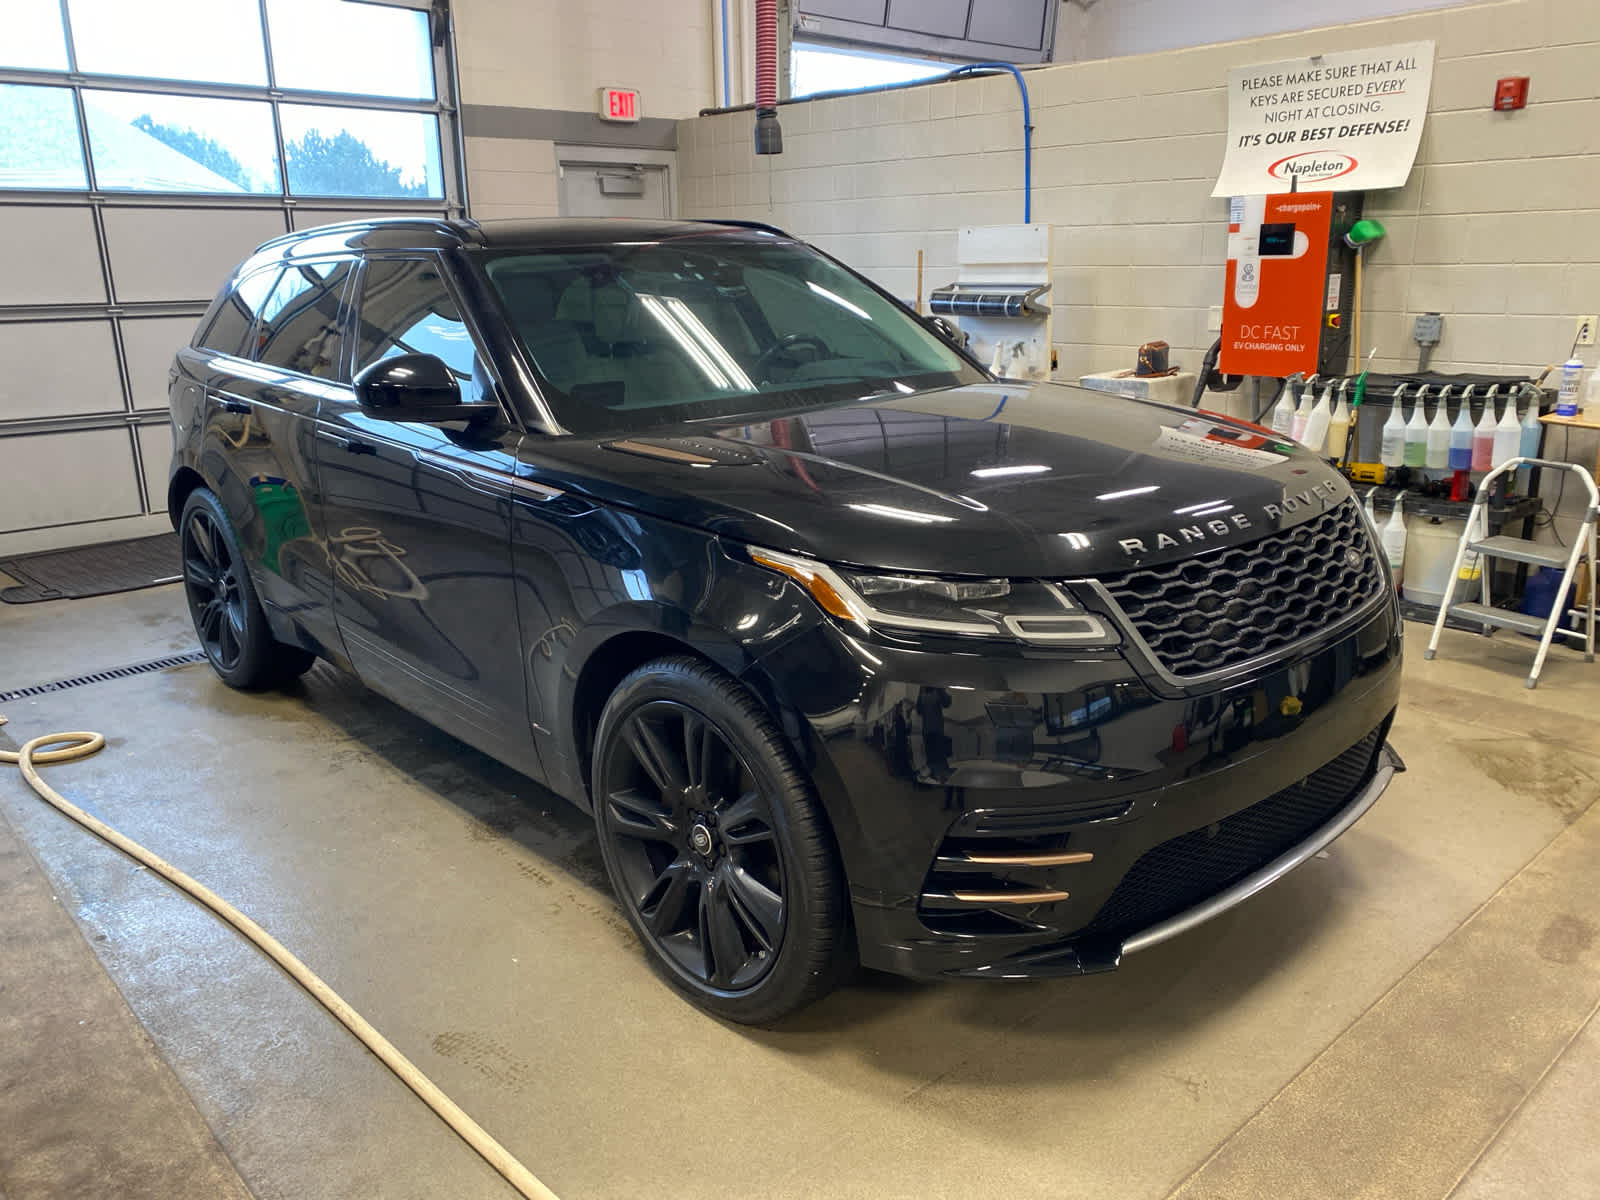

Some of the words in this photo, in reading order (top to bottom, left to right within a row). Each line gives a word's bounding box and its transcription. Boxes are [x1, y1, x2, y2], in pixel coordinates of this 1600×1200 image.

[1242, 74, 1283, 91] PLEASE
[1286, 70, 1322, 85] MAKE
[1325, 64, 1357, 81] SURE
[1360, 61, 1393, 76] THAT
[1395, 57, 1417, 72] ALL
[609, 91, 635, 118] EXIT
[1250, 93, 1279, 108] KEYS
[1280, 89, 1304, 104] ARE
[1306, 83, 1364, 101] SECURED
[1366, 78, 1407, 95] EVERY
[1264, 108, 1303, 124] NIGHT
[1305, 105, 1320, 119] AT
[1322, 100, 1384, 118] CLOSING.
[1239, 134, 1261, 148] IT'S
[1265, 130, 1297, 146] OUR
[1300, 125, 1336, 142] BEST
[1338, 119, 1411, 138] DEFENSE!
[1284, 160, 1344, 175] Napleton
[1240, 325, 1261, 340] DC
[1264, 326, 1301, 341] FAST
[1233, 341, 1245, 350] EV
[1244, 342, 1284, 352] CHARGING
[1285, 344, 1306, 353] ONLY
[1118, 513, 1252, 556] RANGE
[1263, 479, 1338, 520] ROVER
